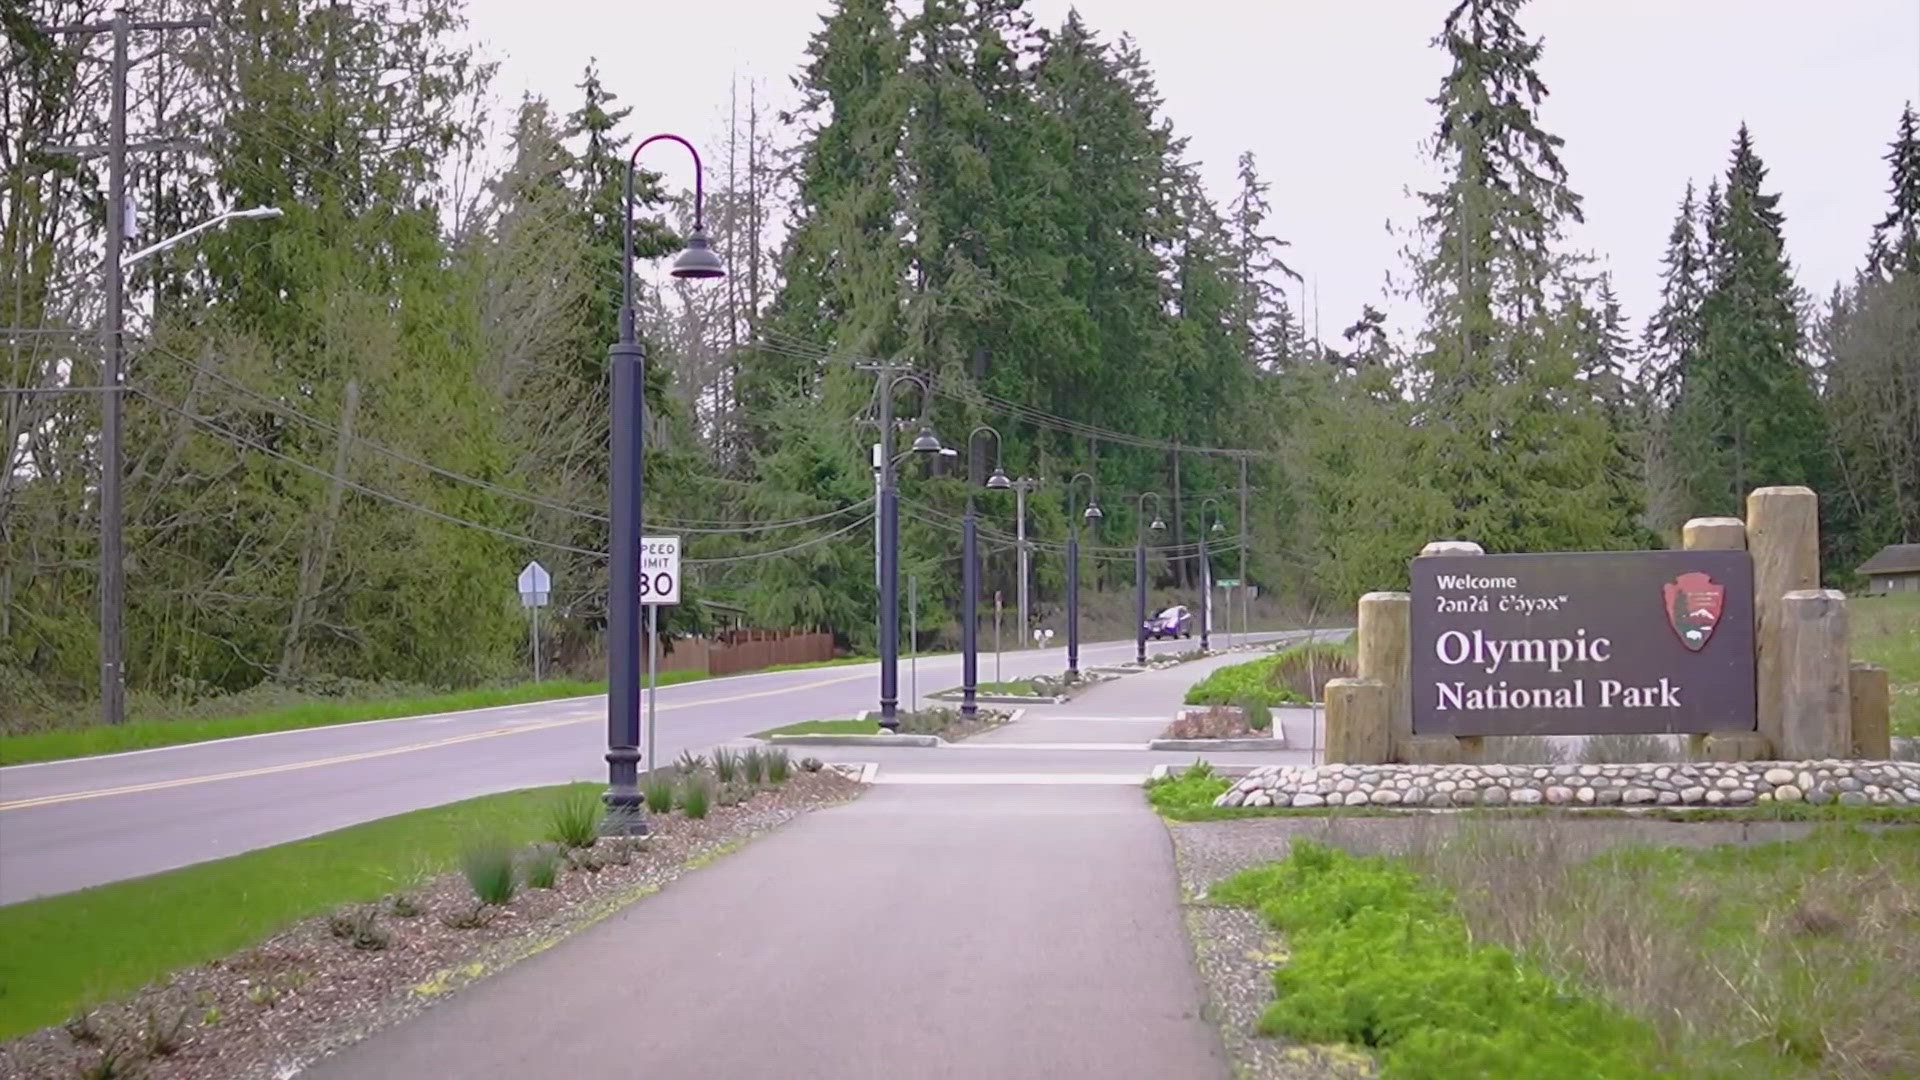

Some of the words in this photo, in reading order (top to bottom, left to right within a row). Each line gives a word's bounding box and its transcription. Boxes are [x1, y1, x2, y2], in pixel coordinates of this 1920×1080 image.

[640, 543, 675, 555] PEED
[643, 557, 669, 568] IMIT
[1437, 574, 1517, 590] Welcome
[1435, 628, 1611, 674] Olympic
[1435, 679, 1584, 710] National
[1599, 678, 1681, 708] Park
